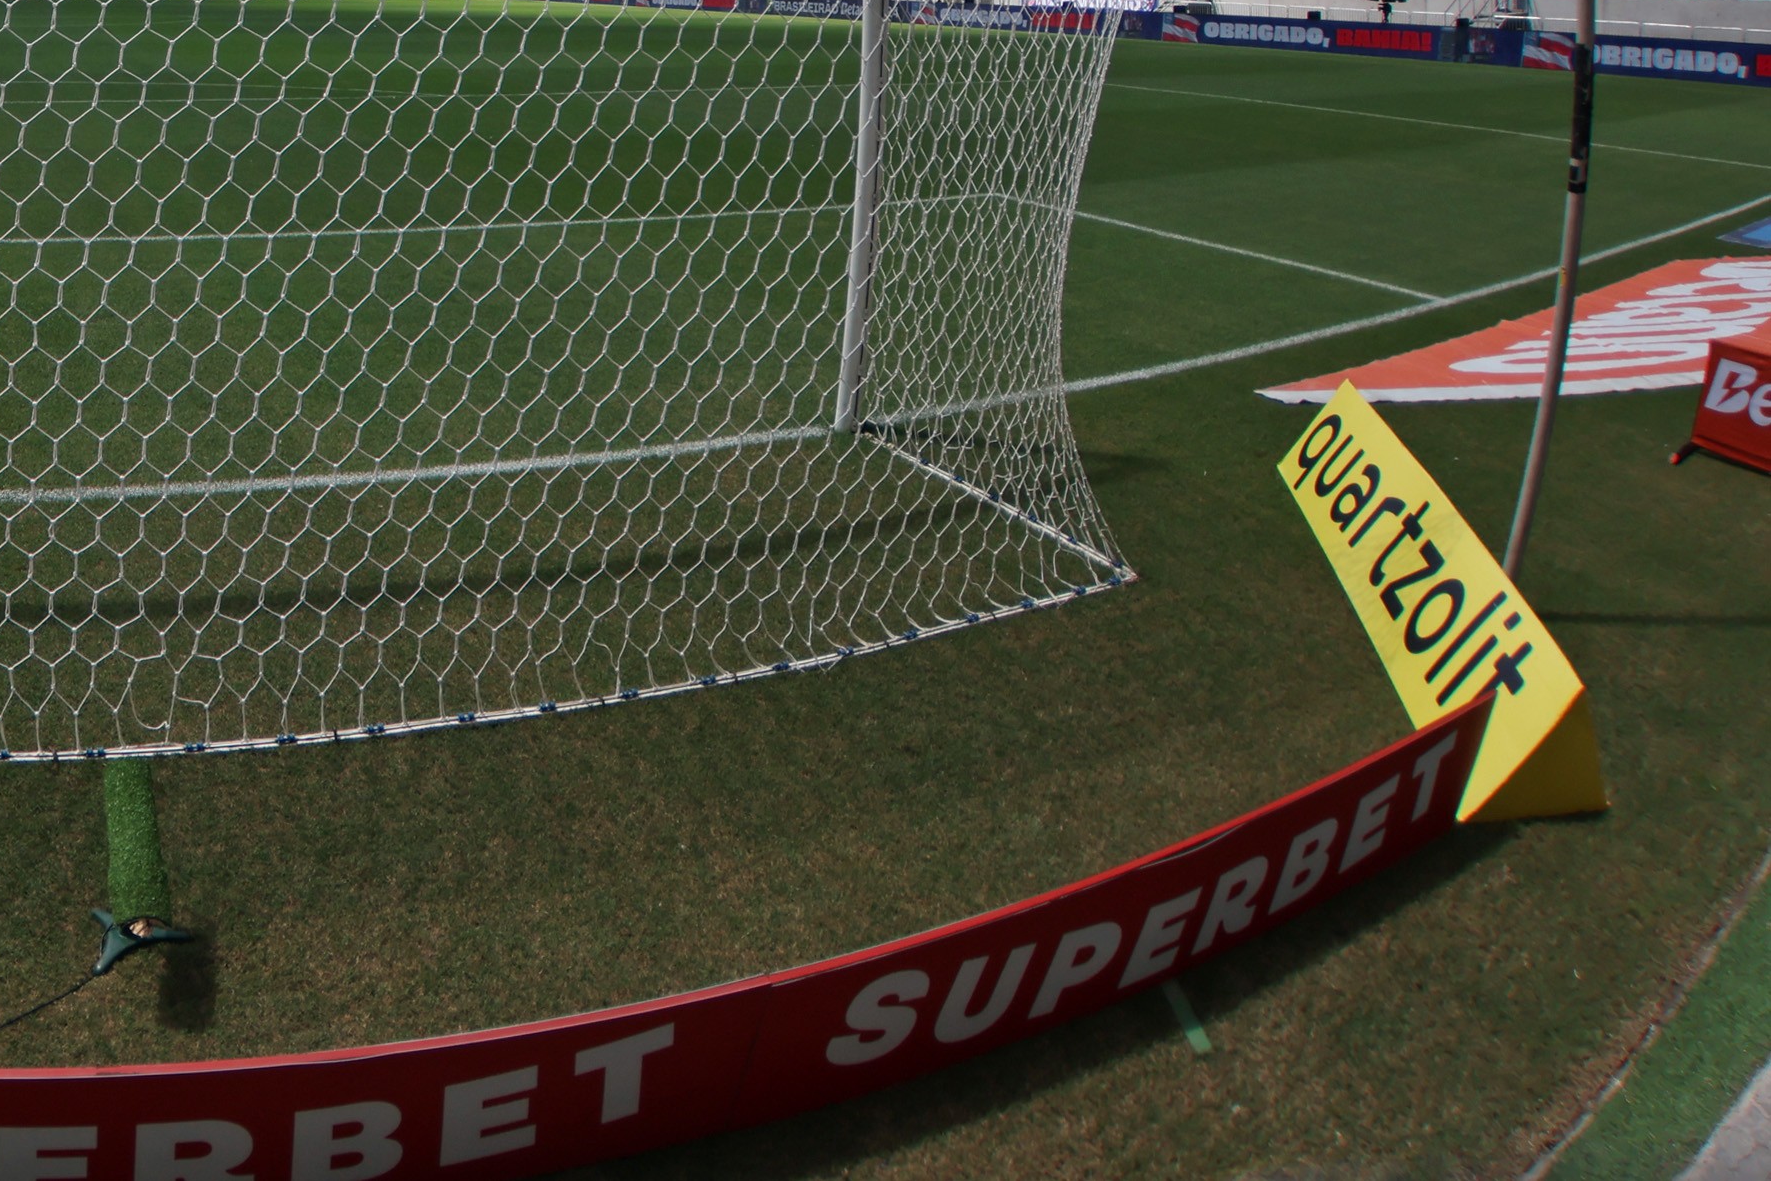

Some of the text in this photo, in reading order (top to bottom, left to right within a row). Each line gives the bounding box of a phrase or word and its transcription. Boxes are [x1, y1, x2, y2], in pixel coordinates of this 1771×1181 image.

[773, 0, 839, 14] BRASILEIRÃO
[1203, 21, 1433, 52] OBRIGADO, BAHIA!
[1293, 413, 1534, 707] quartzolit
[825, 729, 1458, 1067] SUPERBET
